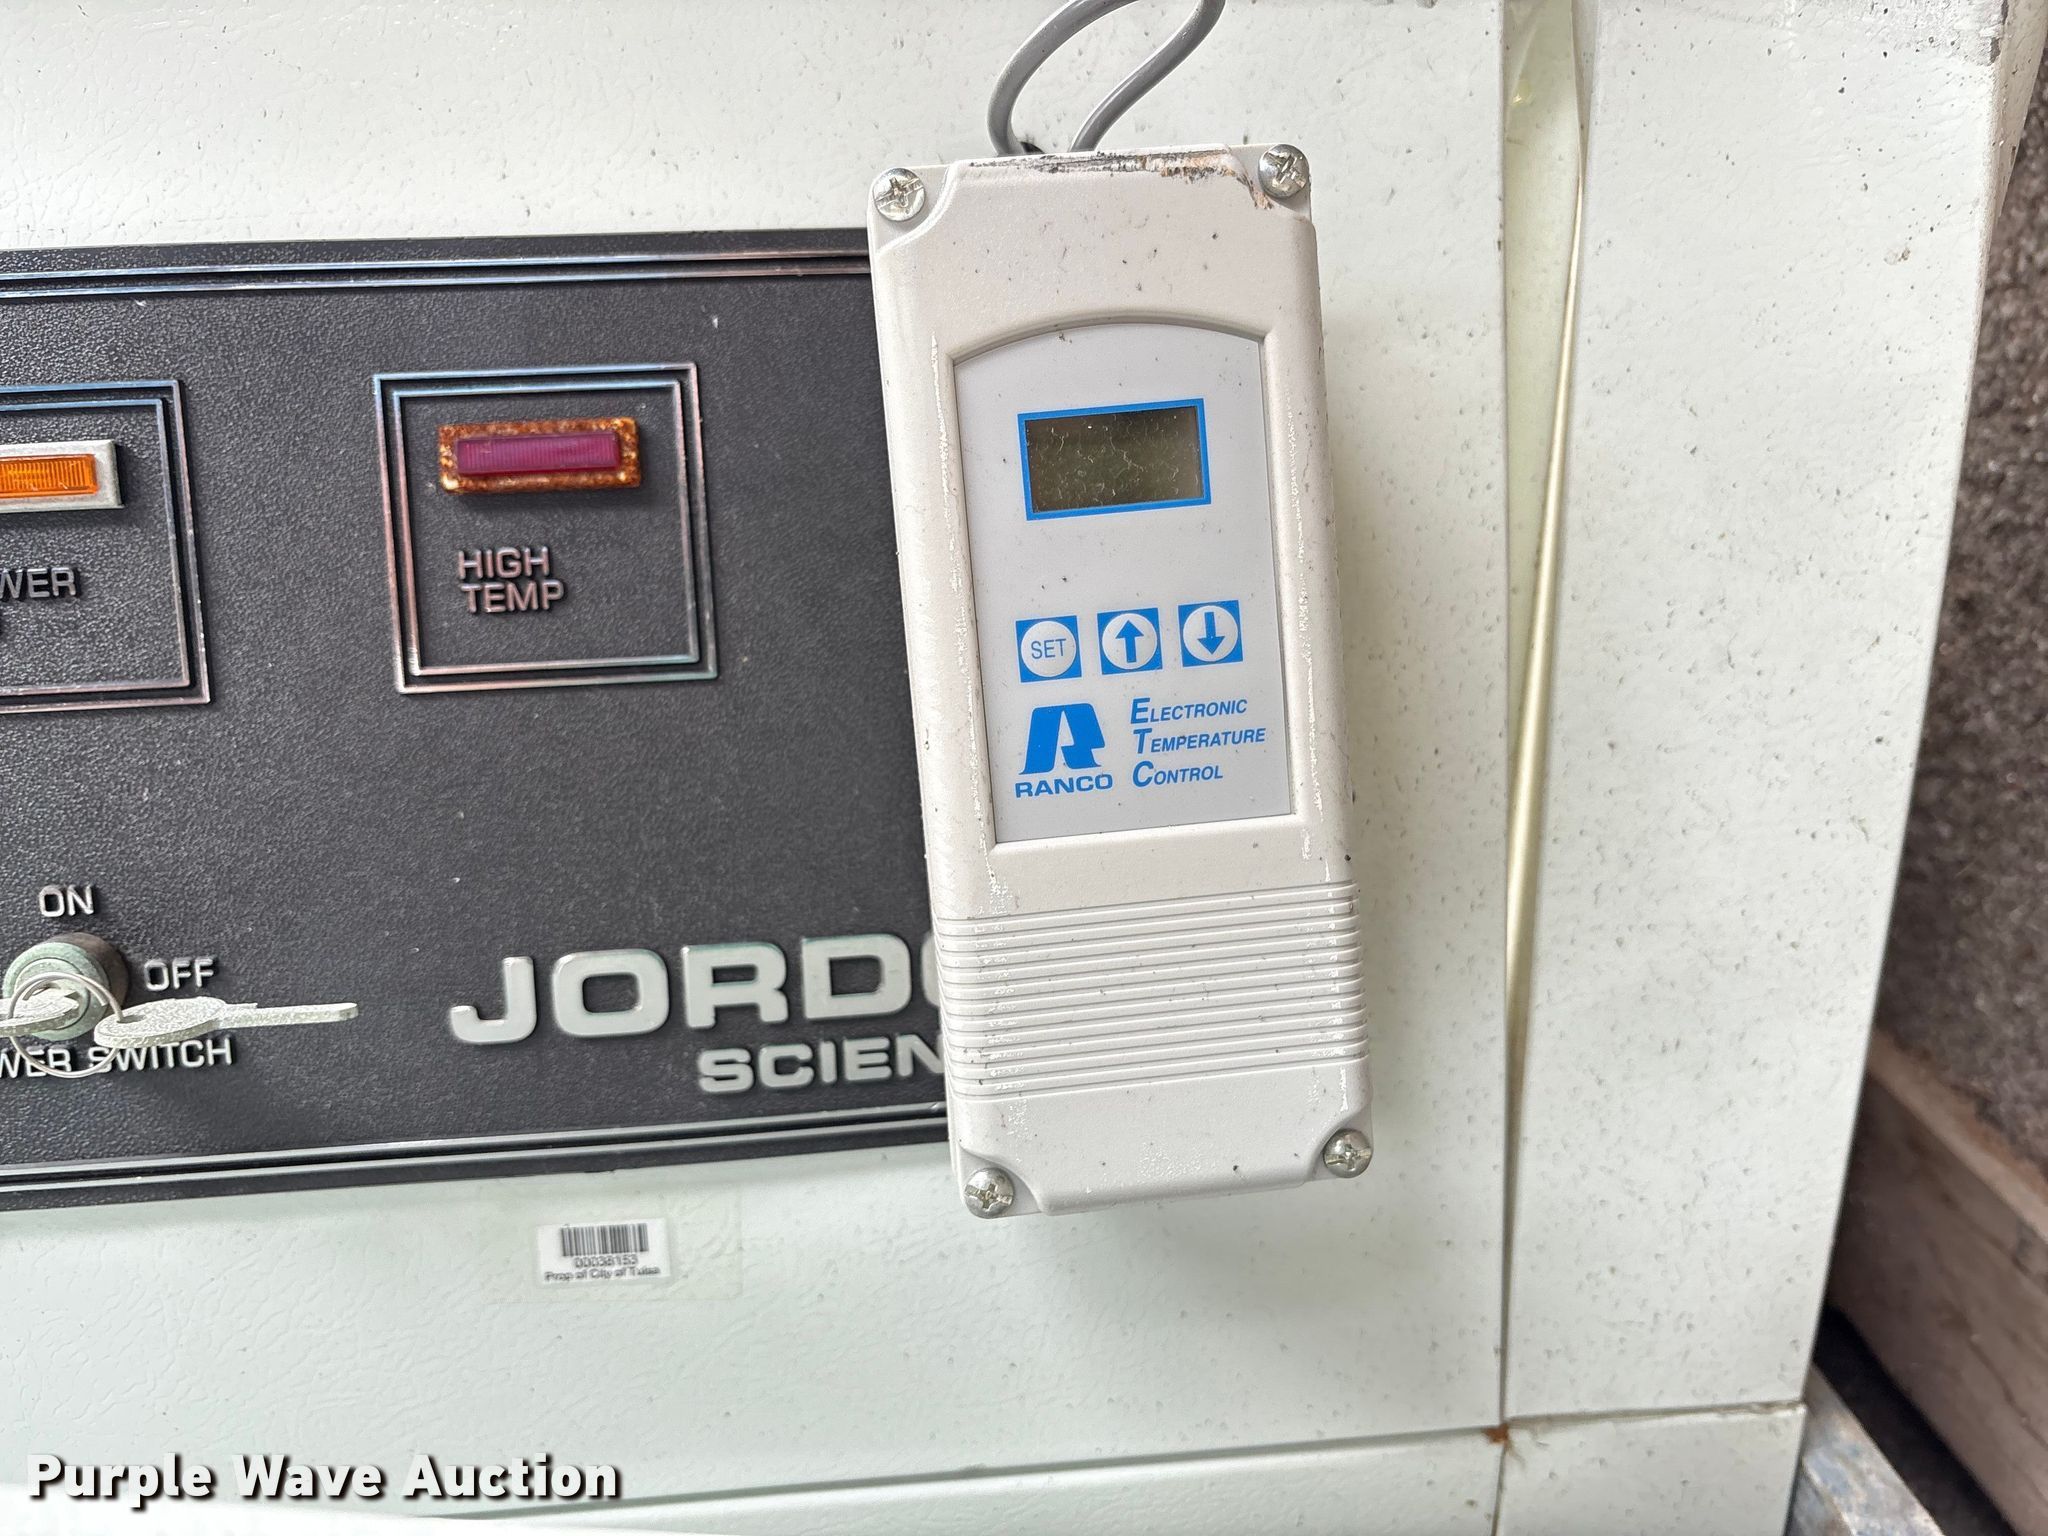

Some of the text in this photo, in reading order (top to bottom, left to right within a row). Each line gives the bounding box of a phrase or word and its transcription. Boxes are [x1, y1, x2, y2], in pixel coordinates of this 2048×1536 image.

[458, 546, 550, 579] HIGH
[460, 580, 565, 613] TEMP
[1030, 638, 1067, 660] SET
[1014, 773, 1114, 798] RANCO
[38, 885, 95, 917] ON
[143, 957, 215, 991] OFF
[449, 932, 940, 1045] JORD
[88, 1037, 232, 1073] SWITCH
[576, 1269, 587, 1279] of
[590, 1267, 612, 1279] City
[615, 1266, 626, 1276] of
